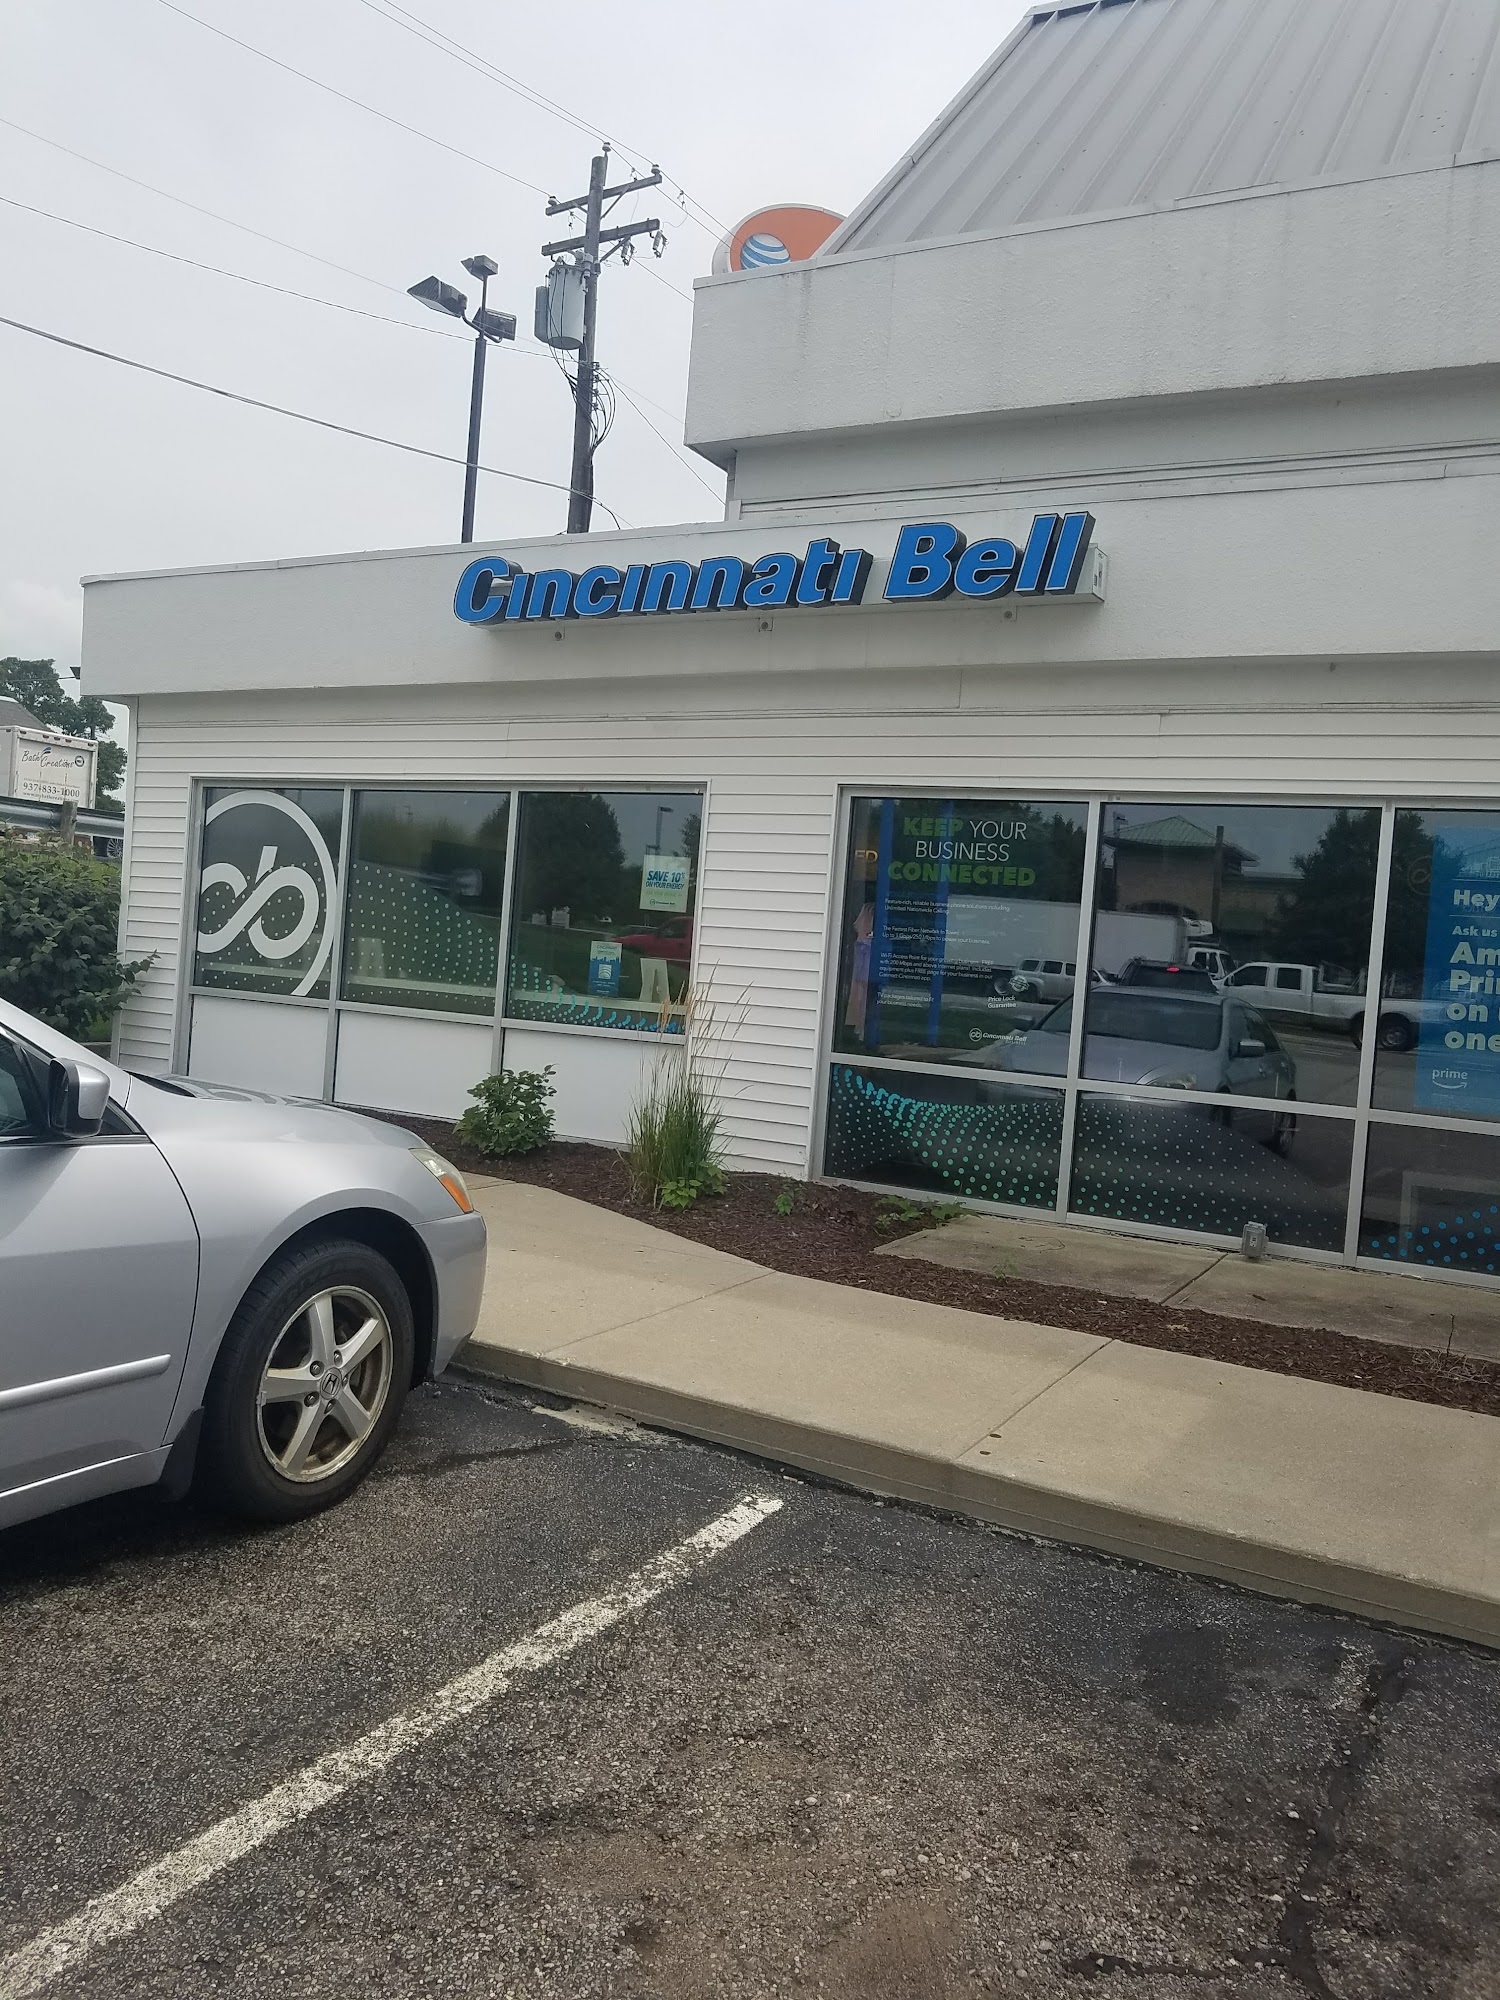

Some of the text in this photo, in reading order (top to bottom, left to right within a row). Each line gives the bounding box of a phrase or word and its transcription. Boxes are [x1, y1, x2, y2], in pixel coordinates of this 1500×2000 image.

[453, 511, 1096, 625] Cincinnati Bell
[21, 750, 75, 768] Bath Creations
[23, 782, 80, 798] 937-833-1000
[903, 817, 1027, 839] KEEP YOUR
[915, 841, 1010, 861] BUSINESS
[647, 870, 669, 882] SAVE
[887, 861, 1036, 886] CONNECTED
[653, 881, 666, 889] YOUR
[1453, 889, 1500, 912] Hey
[1452, 925, 1498, 938] Ask us
[1449, 941, 1500, 965] Am
[1450, 969, 1500, 994] Pri
[1447, 1003, 1488, 1022] on
[982, 1032, 1013, 1041] Cincinnati
[1445, 1031, 1500, 1052] one
[1432, 1068, 1468, 1079] prime
